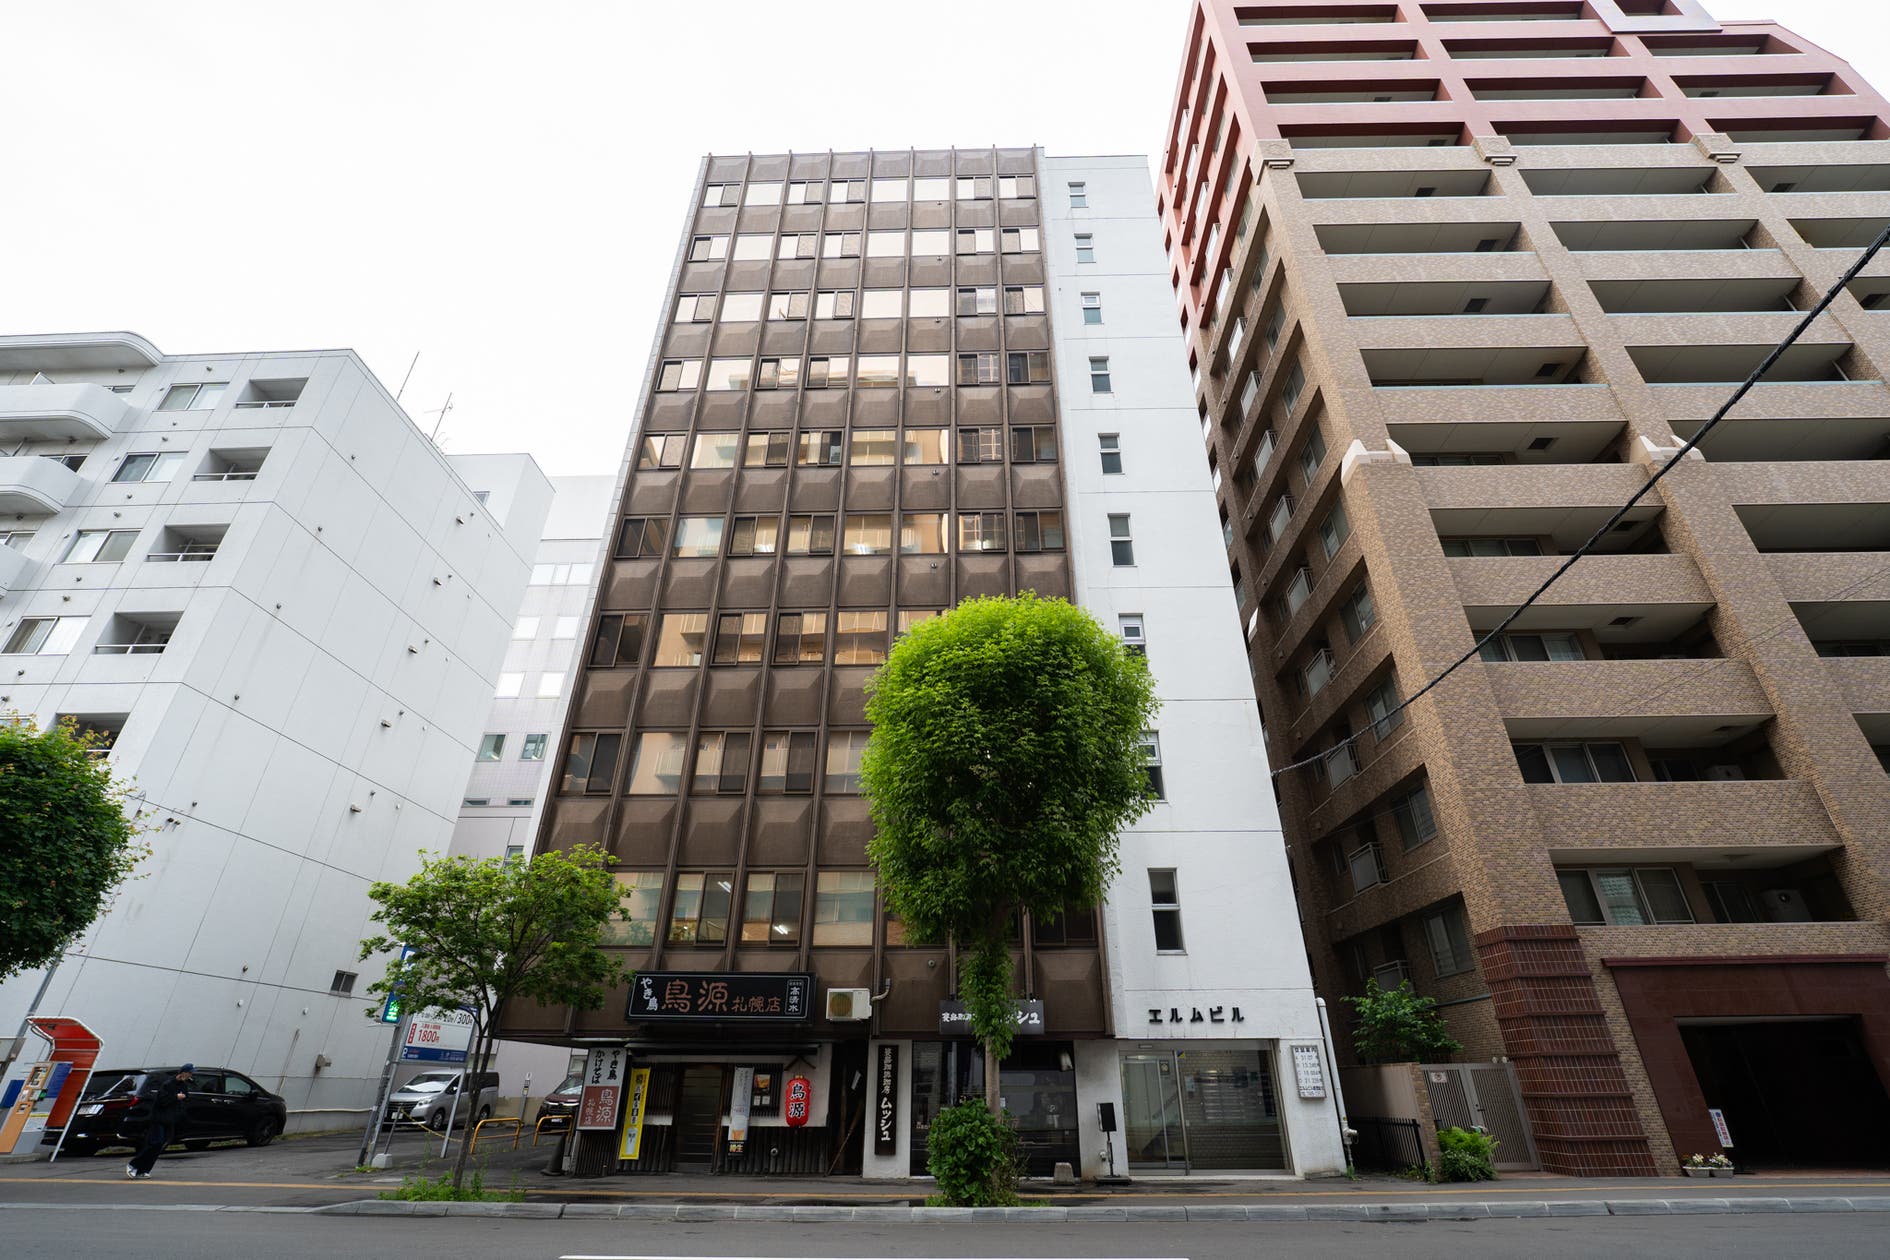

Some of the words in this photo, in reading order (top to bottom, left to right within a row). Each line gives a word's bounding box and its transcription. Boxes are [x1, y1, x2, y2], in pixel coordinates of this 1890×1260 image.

[640, 977, 659, 1011] やき鳥
[661, 979, 729, 1013] 鳥源
[731, 996, 781, 1013] 札幌店
[1148, 1006, 1245, 1023] エルムビル
[592, 1049, 605, 1085] かけそば
[607, 1049, 620, 1081] やき鳥
[595, 1088, 614, 1123] 鳥源
[789, 1082, 806, 1119] 鳥源
[880, 1097, 892, 1141] ムッシュ
